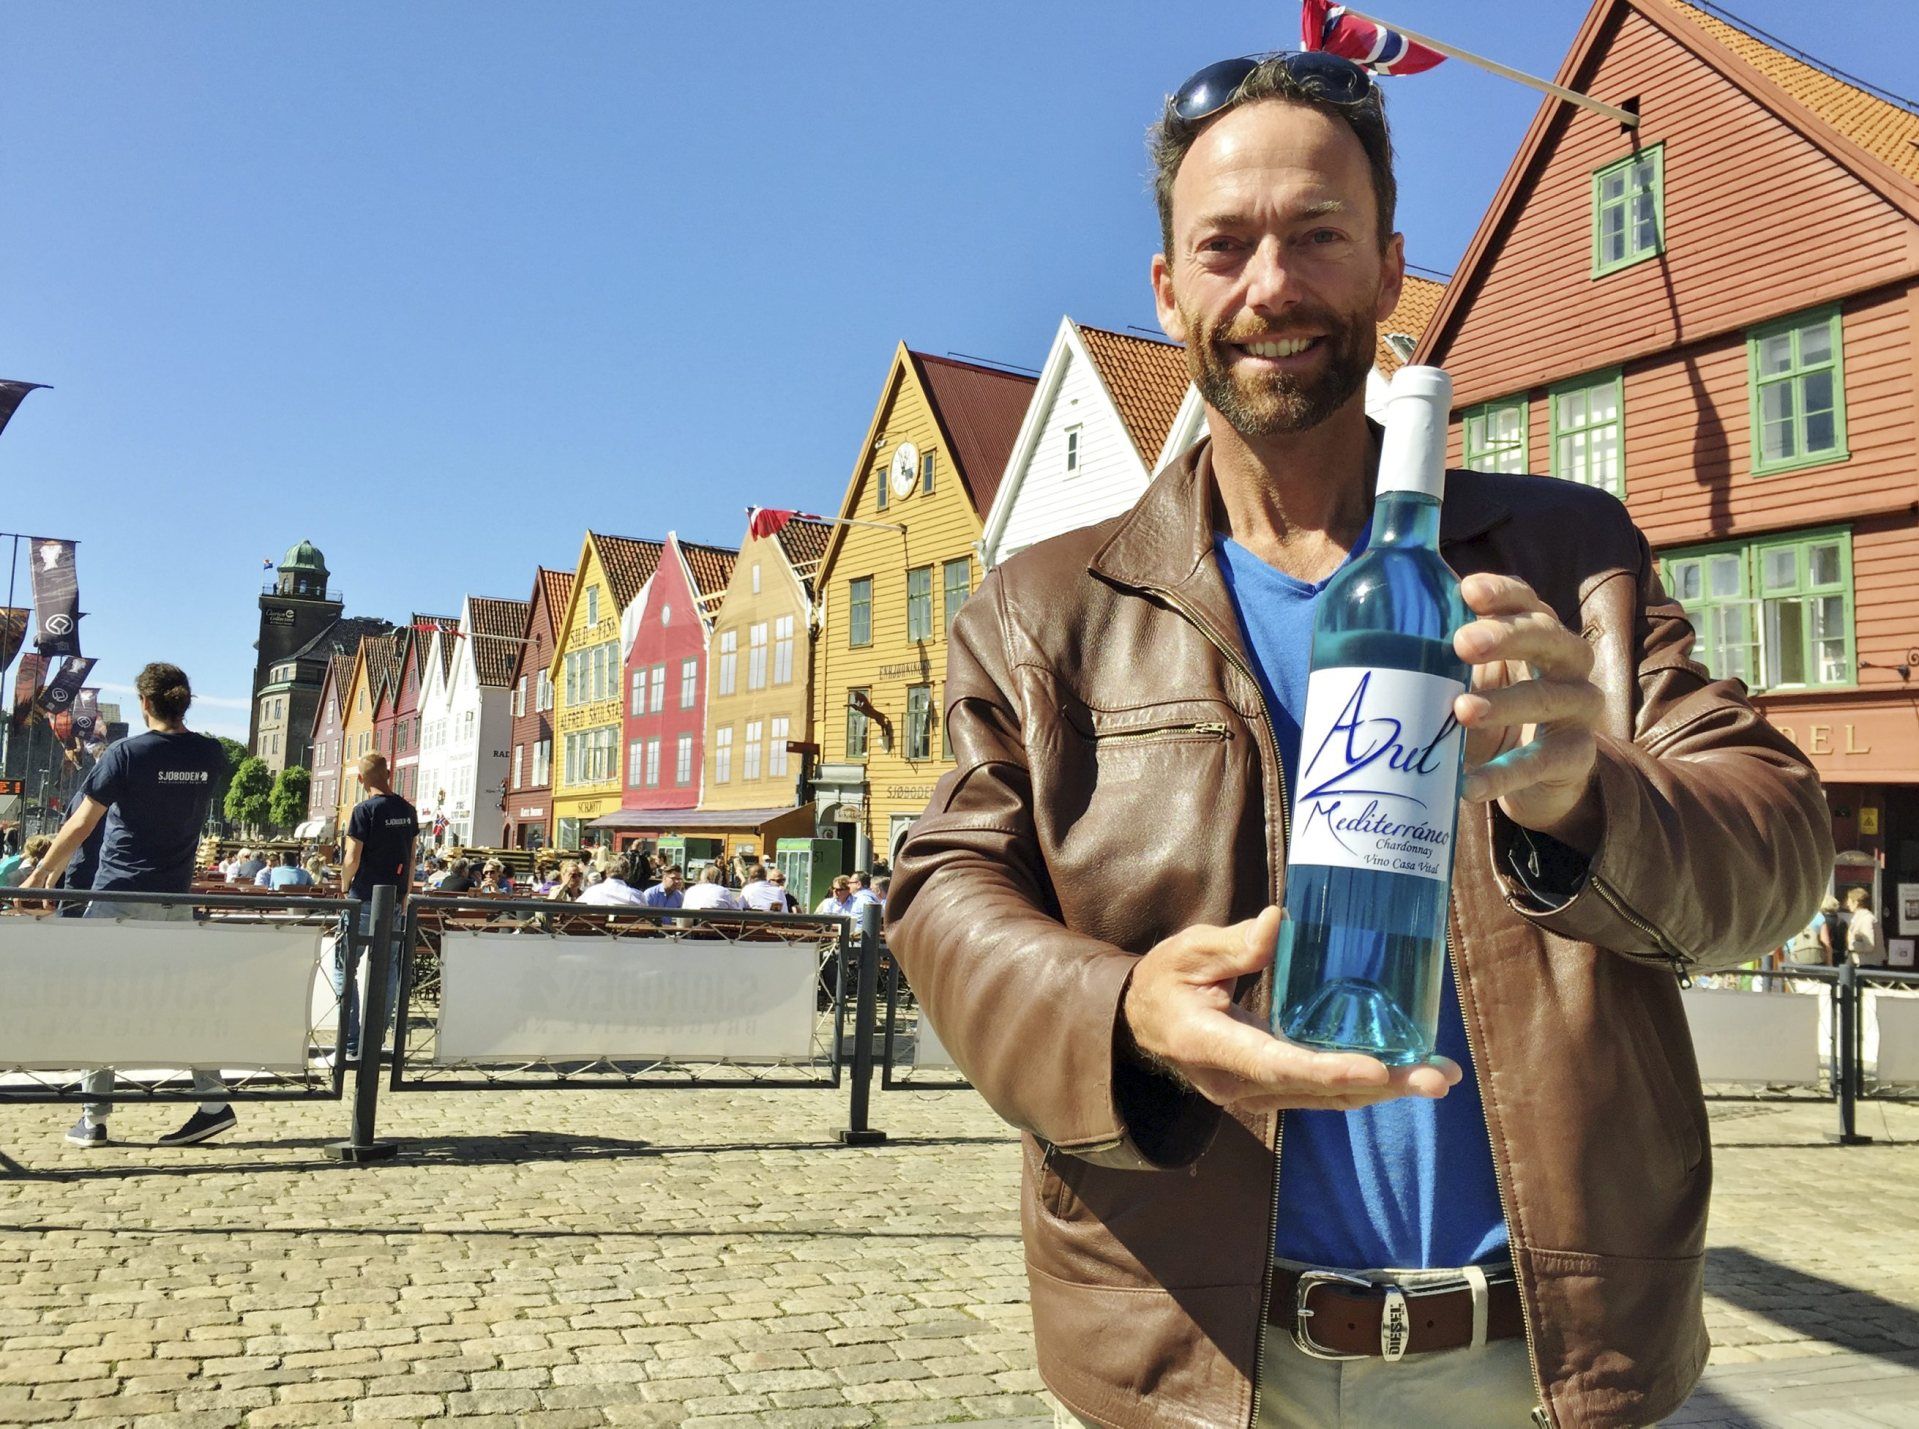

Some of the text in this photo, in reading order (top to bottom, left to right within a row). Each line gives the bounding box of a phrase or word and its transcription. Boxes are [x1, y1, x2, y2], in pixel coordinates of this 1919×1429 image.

[1302, 800, 1449, 856] Mediterráneo
[1364, 853, 1439, 875] Vino Casa Vital
[1376, 838, 1434, 859] Chardonnay
[1389, 1304, 1402, 1355] DIESEL
